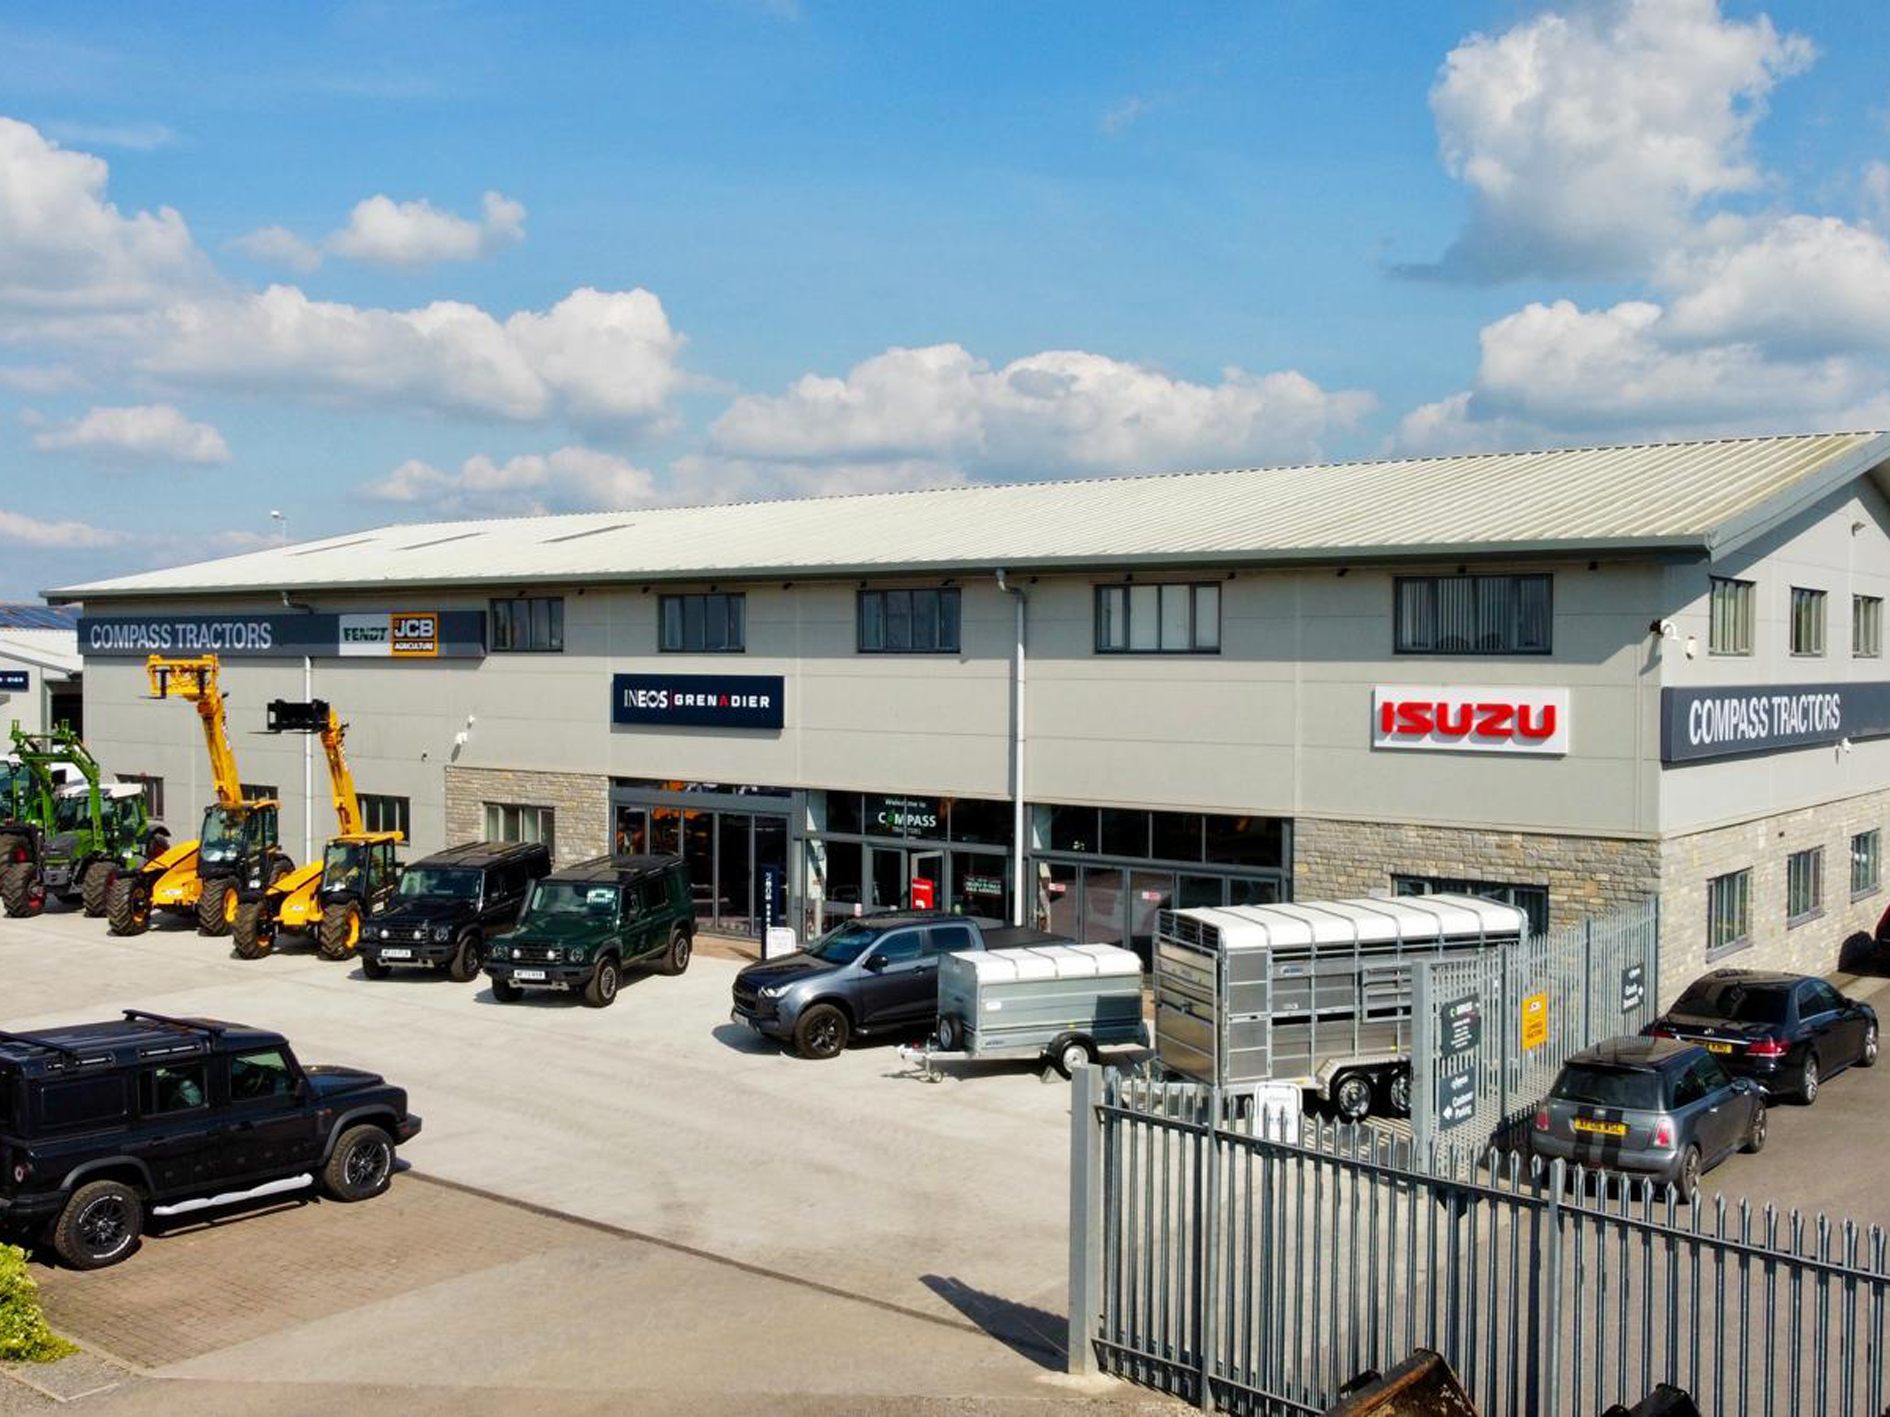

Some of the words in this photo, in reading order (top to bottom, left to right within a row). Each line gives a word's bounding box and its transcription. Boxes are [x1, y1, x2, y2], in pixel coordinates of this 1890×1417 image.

[90, 624, 172, 649] COMPASS
[175, 622, 272, 649] TRACTORS
[343, 626, 388, 642] FENDT
[394, 618, 434, 637] JCB
[624, 689, 668, 708] INEOS
[674, 693, 770, 708] GRENADIER
[1381, 701, 1556, 738] ISUZU
[1689, 696, 1769, 746] COMPASS
[1772, 692, 1841, 736] TRACTORS
[878, 811, 937, 828] COMPASS
